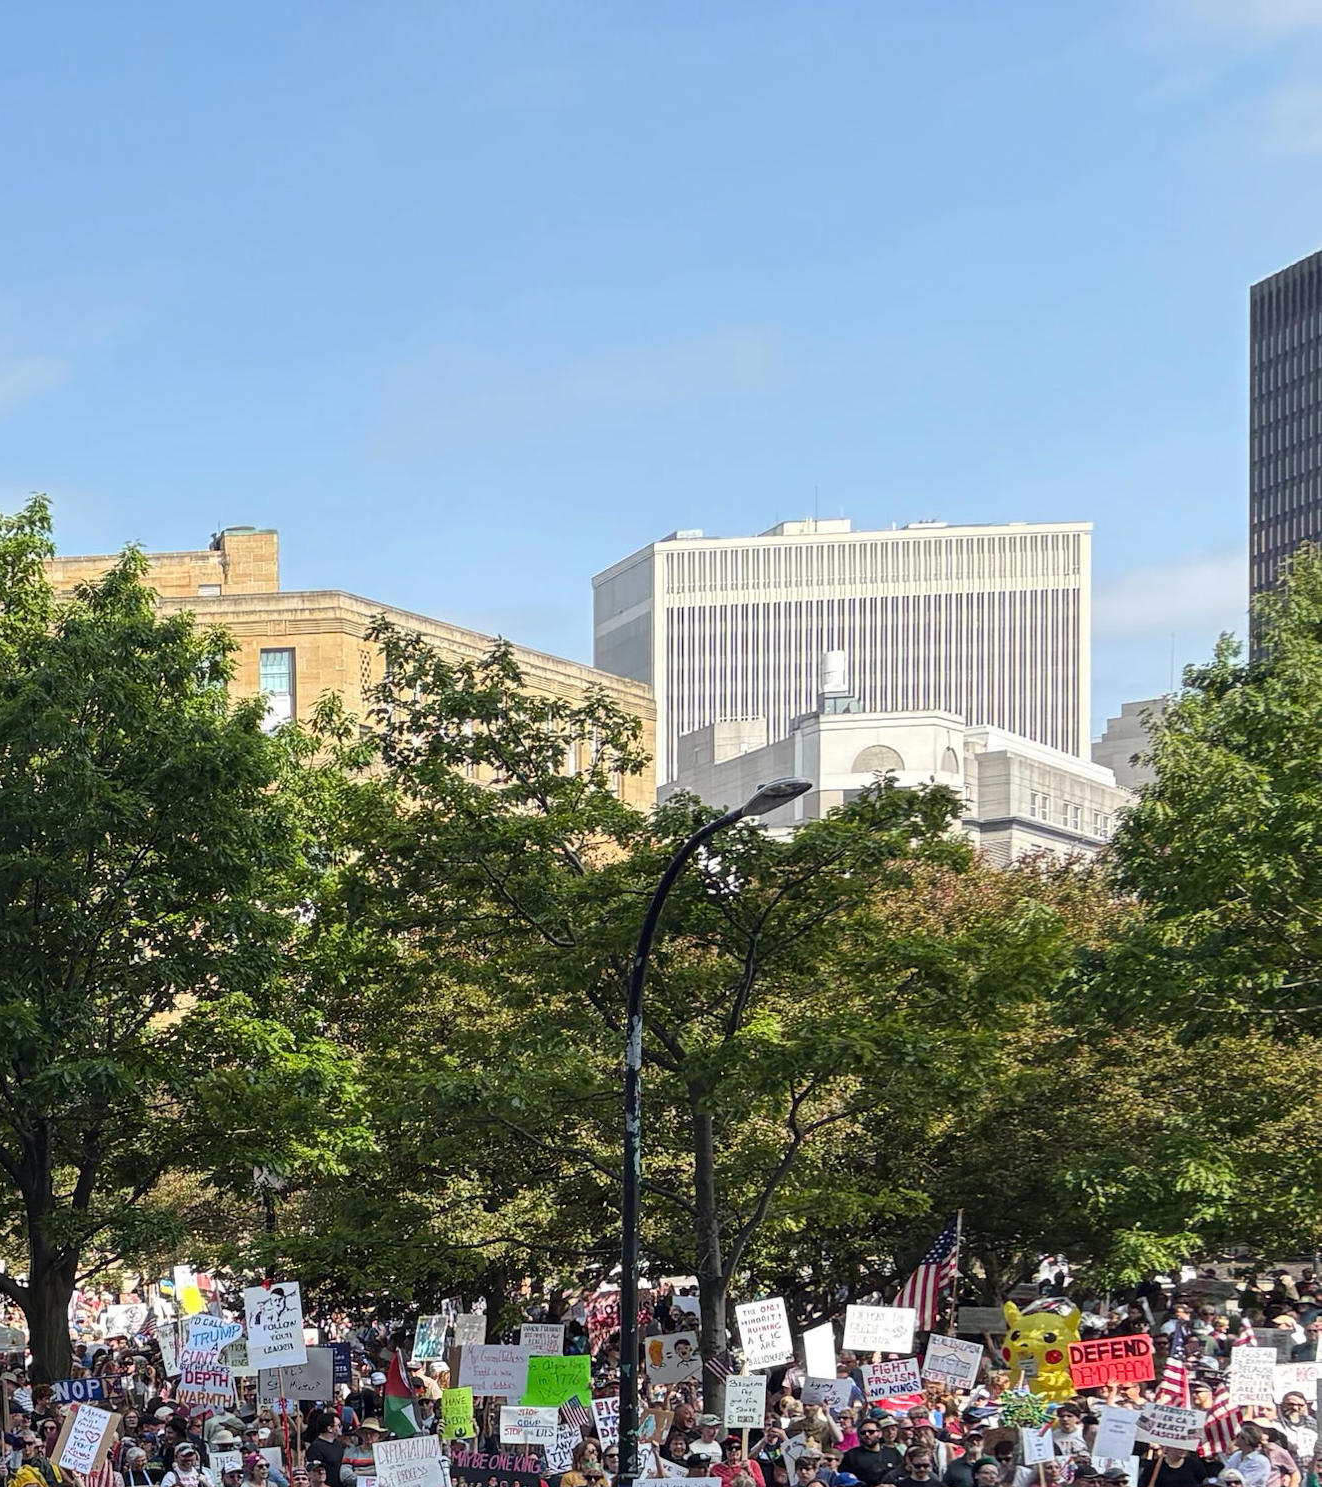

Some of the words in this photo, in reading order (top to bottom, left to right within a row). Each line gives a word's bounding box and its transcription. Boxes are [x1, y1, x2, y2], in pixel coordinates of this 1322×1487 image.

[203, 1318, 224, 1328] CALL
[263, 1320, 298, 1332] FOLLOW
[193, 1326, 242, 1347] TRUMP
[270, 1333, 294, 1341] YOUR
[211, 1342, 219, 1351] A
[760, 1340, 777, 1350] ARE
[1070, 1339, 1151, 1365] DEFEND
[181, 1350, 218, 1366] CUNT
[872, 1361, 910, 1376] FIGHT
[1071, 1359, 1155, 1389] DEMOCRACY
[185, 1371, 229, 1388] DEPTH
[867, 1372, 918, 1386] FASCISM
[869, 1386, 886, 1397] NO
[888, 1381, 921, 1396] KINGS
[177, 1389, 233, 1407] WARMTH
[518, 1408, 540, 1416] STOP
[517, 1419, 541, 1427] COUP
[1157, 1421, 1186, 1434] REJECT
[504, 1428, 523, 1436] STOP
[536, 1429, 555, 1438] LIES
[452, 1451, 489, 1469] MAYBE
[489, 1453, 512, 1471] ONE
[514, 1454, 542, 1474] KING
